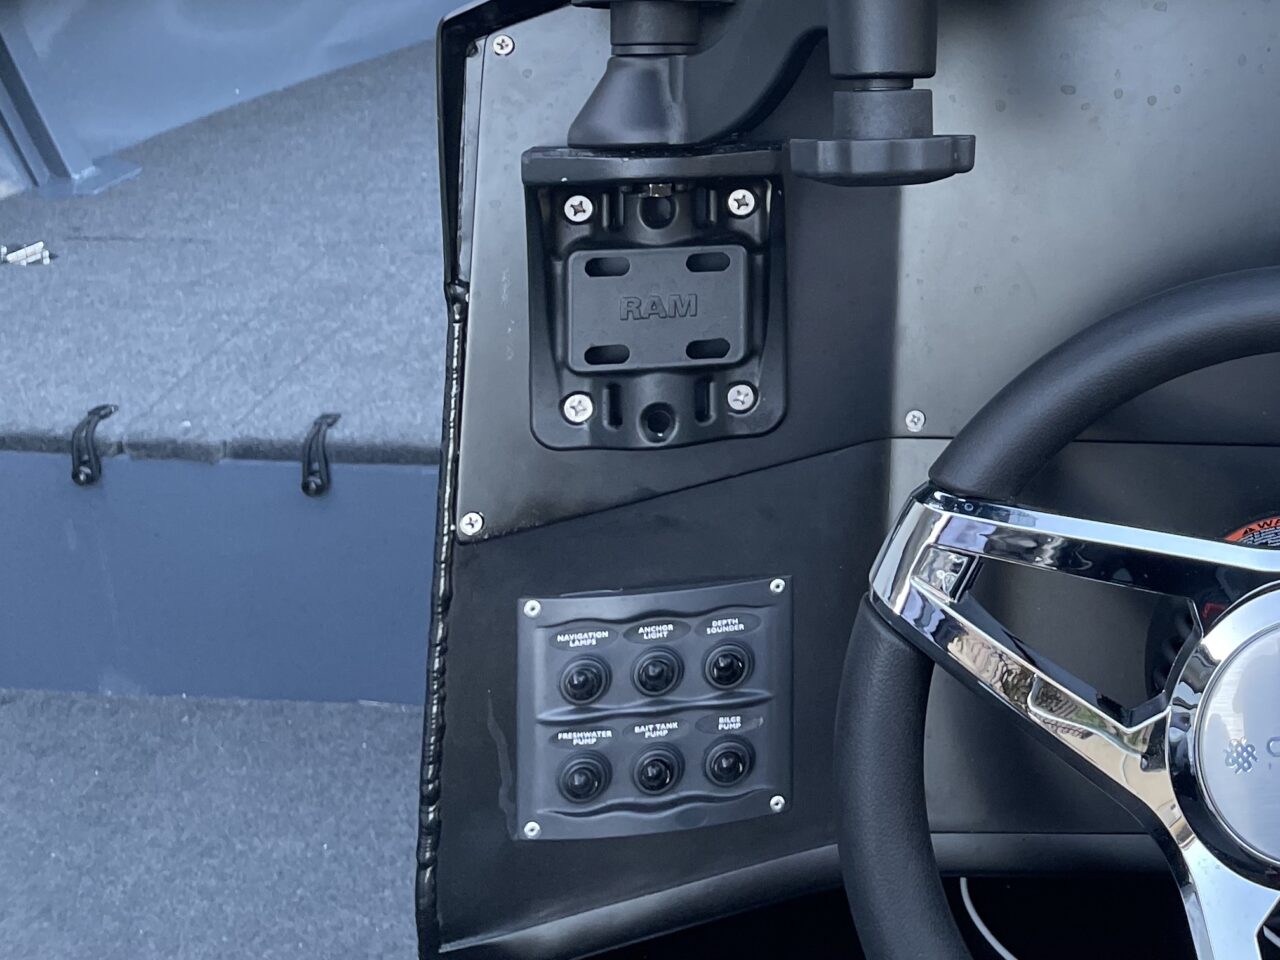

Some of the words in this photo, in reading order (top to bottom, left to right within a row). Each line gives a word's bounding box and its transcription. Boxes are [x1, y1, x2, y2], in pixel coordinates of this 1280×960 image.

[619, 293, 698, 321] RAM
[712, 618, 738, 627] DEPTH
[638, 624, 674, 634] ANCHOR
[706, 624, 745, 635] SOUNDER
[557, 630, 609, 642] NAVIGATION
[643, 631, 669, 640] LIGHT
[569, 638, 597, 647] LAMPS
[718, 716, 741, 724] BILGE
[634, 725, 653, 734] BAIT
[655, 722, 678, 732] TANK
[718, 722, 742, 731] PUMP
[558, 730, 612, 740] FRESHWATER
[645, 729, 669, 738] PUMP
[573, 737, 597, 746] PUMP
